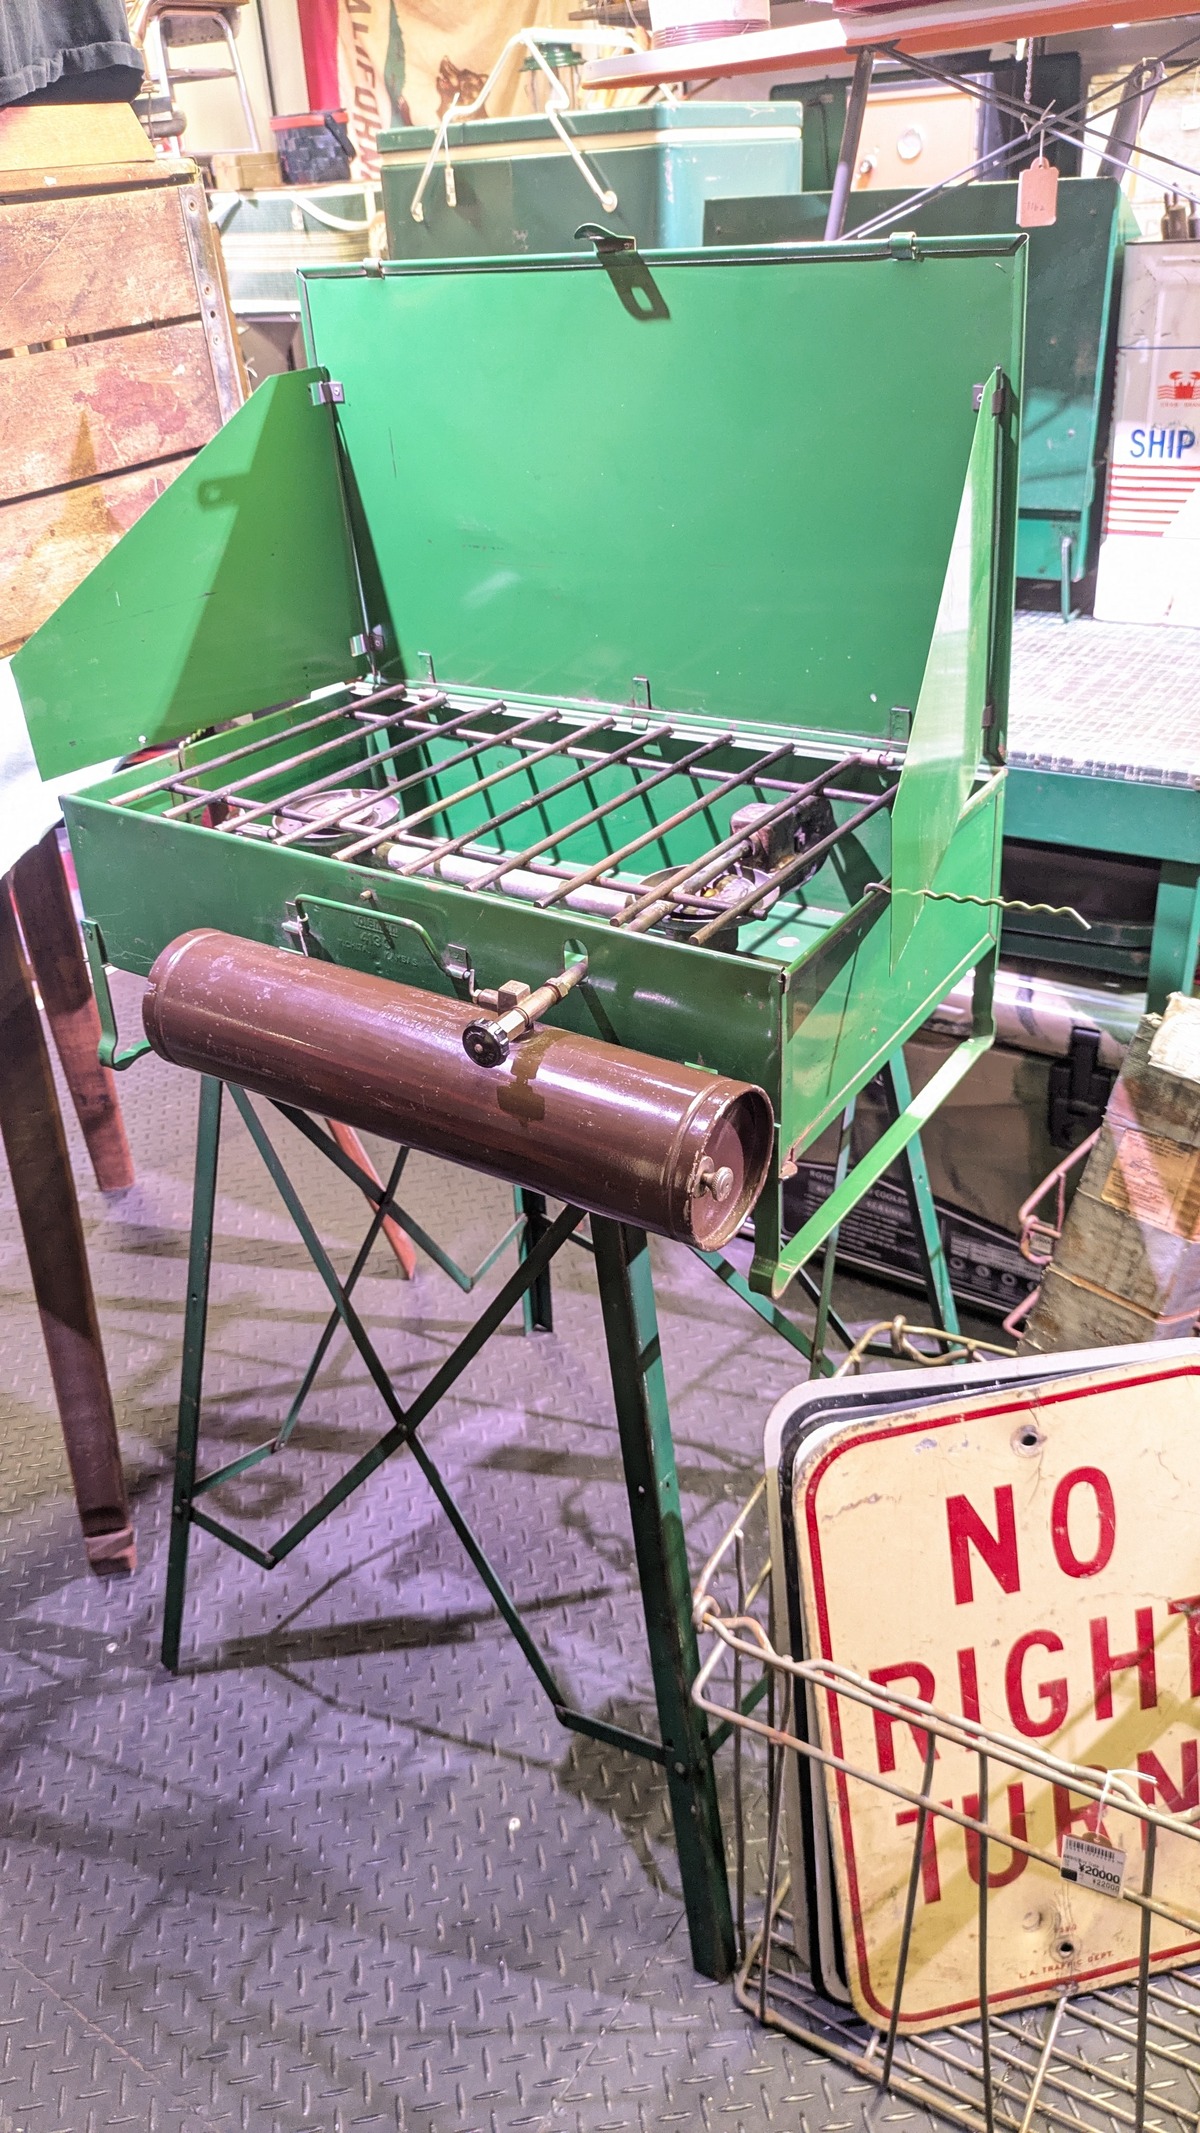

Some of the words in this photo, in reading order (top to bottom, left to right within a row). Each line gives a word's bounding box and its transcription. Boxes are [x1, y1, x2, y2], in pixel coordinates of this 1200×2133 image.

[1130, 429, 1196, 459] SHIP
[945, 1465, 1116, 1605] NO
[868, 1594, 1200, 1774] RIGHT
[896, 1739, 1198, 1905] TURN
[1079, 1862, 1121, 1885] ¥20000
[1029, 1969, 1039, 1978] A.
[1042, 1958, 1083, 1974] TRAFFIC
[1087, 1950, 1115, 1964] DEPT.
